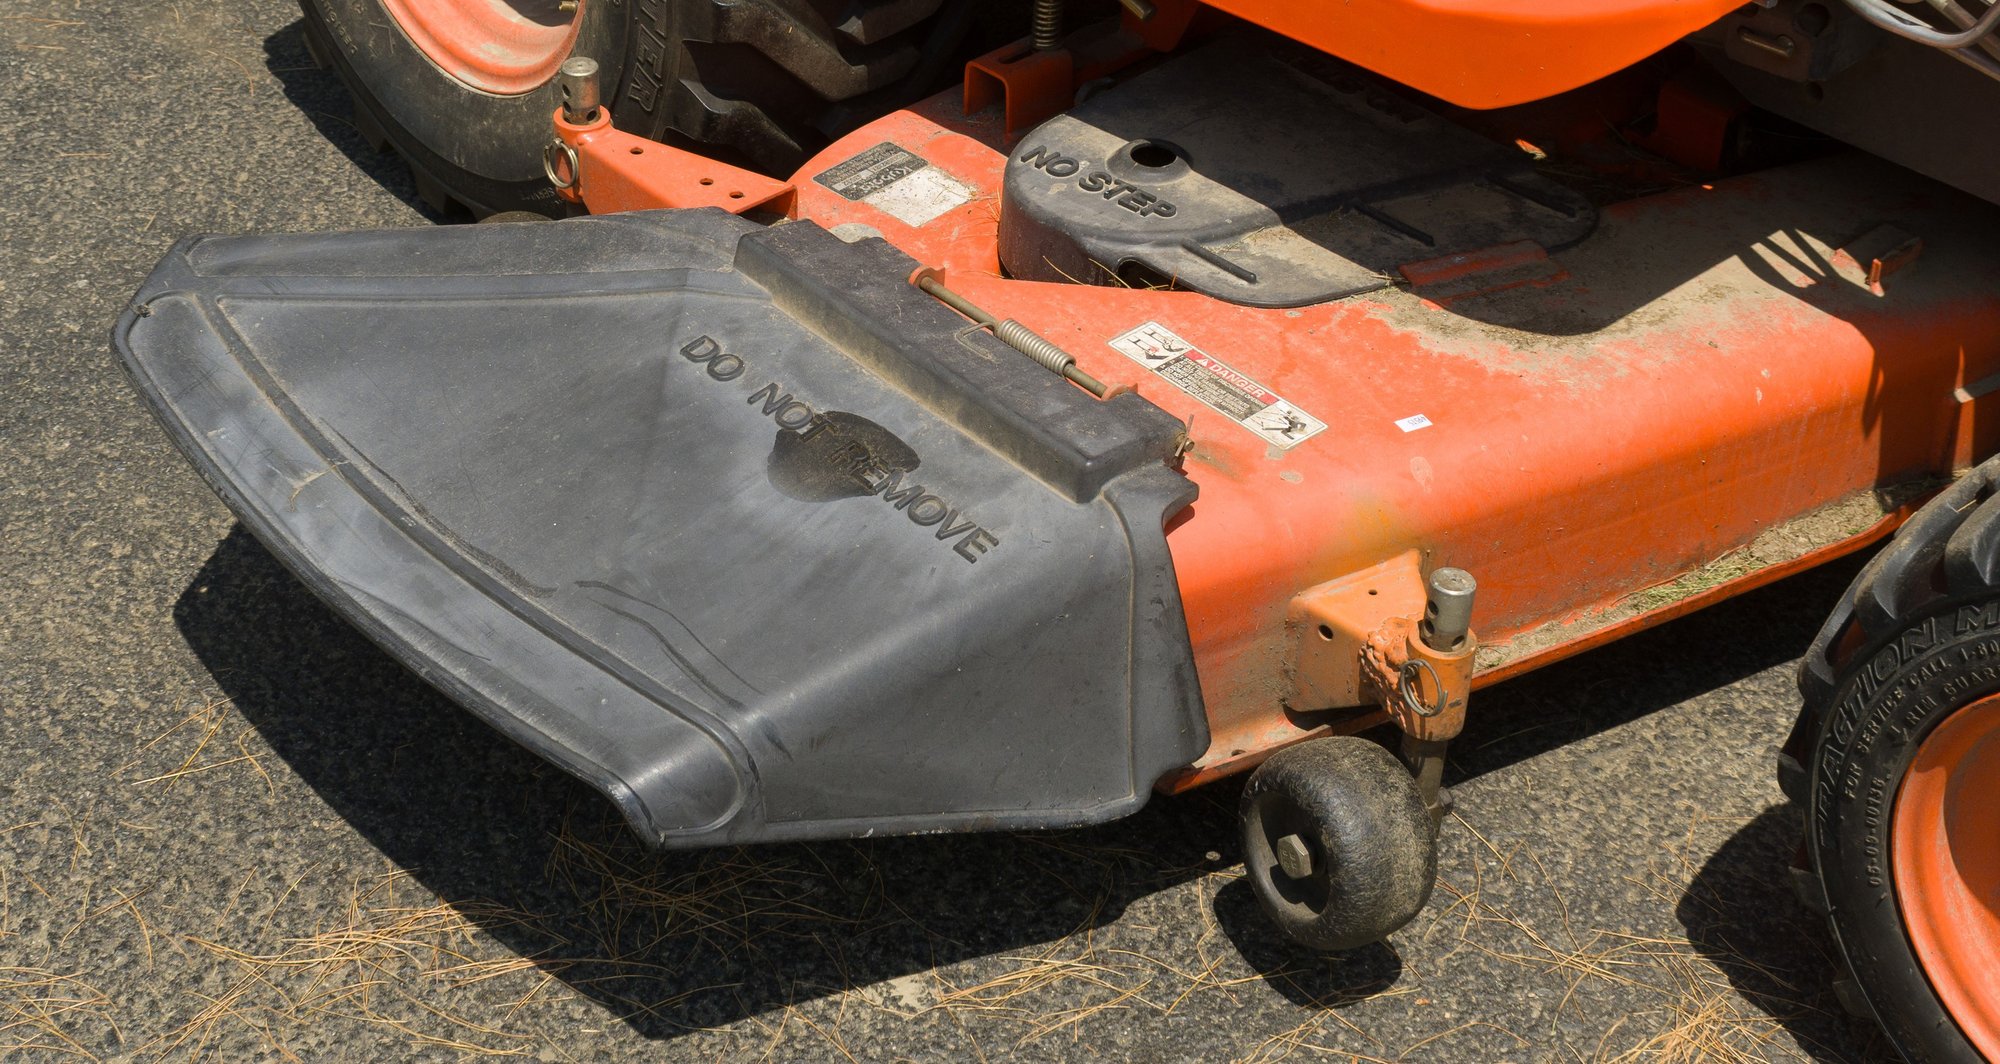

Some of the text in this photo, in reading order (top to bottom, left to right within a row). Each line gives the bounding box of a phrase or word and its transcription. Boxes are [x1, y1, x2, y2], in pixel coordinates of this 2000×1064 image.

[860, 166, 913, 191] Kubota
[1020, 145, 1177, 218] NO STEP
[1208, 361, 1267, 398] DANGER
[679, 335, 1000, 564] DO NOT REMOVE
[1844, 762, 1863, 799] FOR
[1857, 686, 1905, 753] SERVICE
[1909, 656, 1952, 686] CALL
[1906, 664, 2000, 725] RIM GUAR
[1817, 616, 1936, 847] TRACTION
